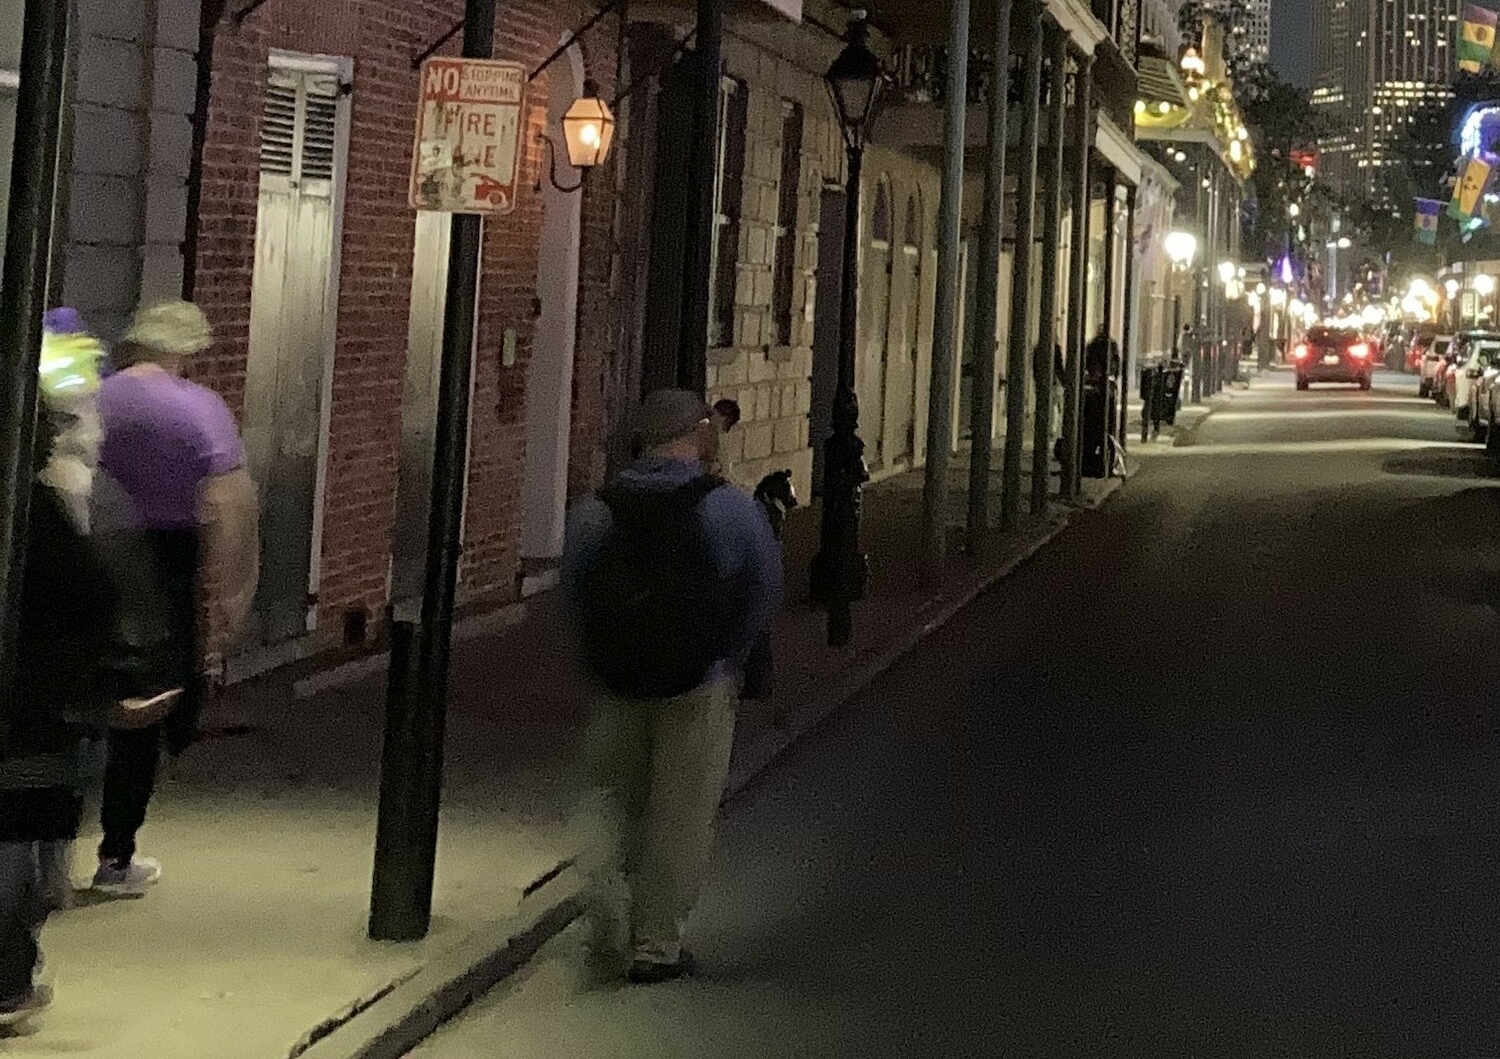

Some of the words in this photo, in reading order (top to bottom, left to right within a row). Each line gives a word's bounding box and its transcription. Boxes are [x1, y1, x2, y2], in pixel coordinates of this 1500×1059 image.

[426, 66, 461, 96] NO
[465, 84, 516, 100] ANYTIME
[445, 112, 496, 136] FIRE
